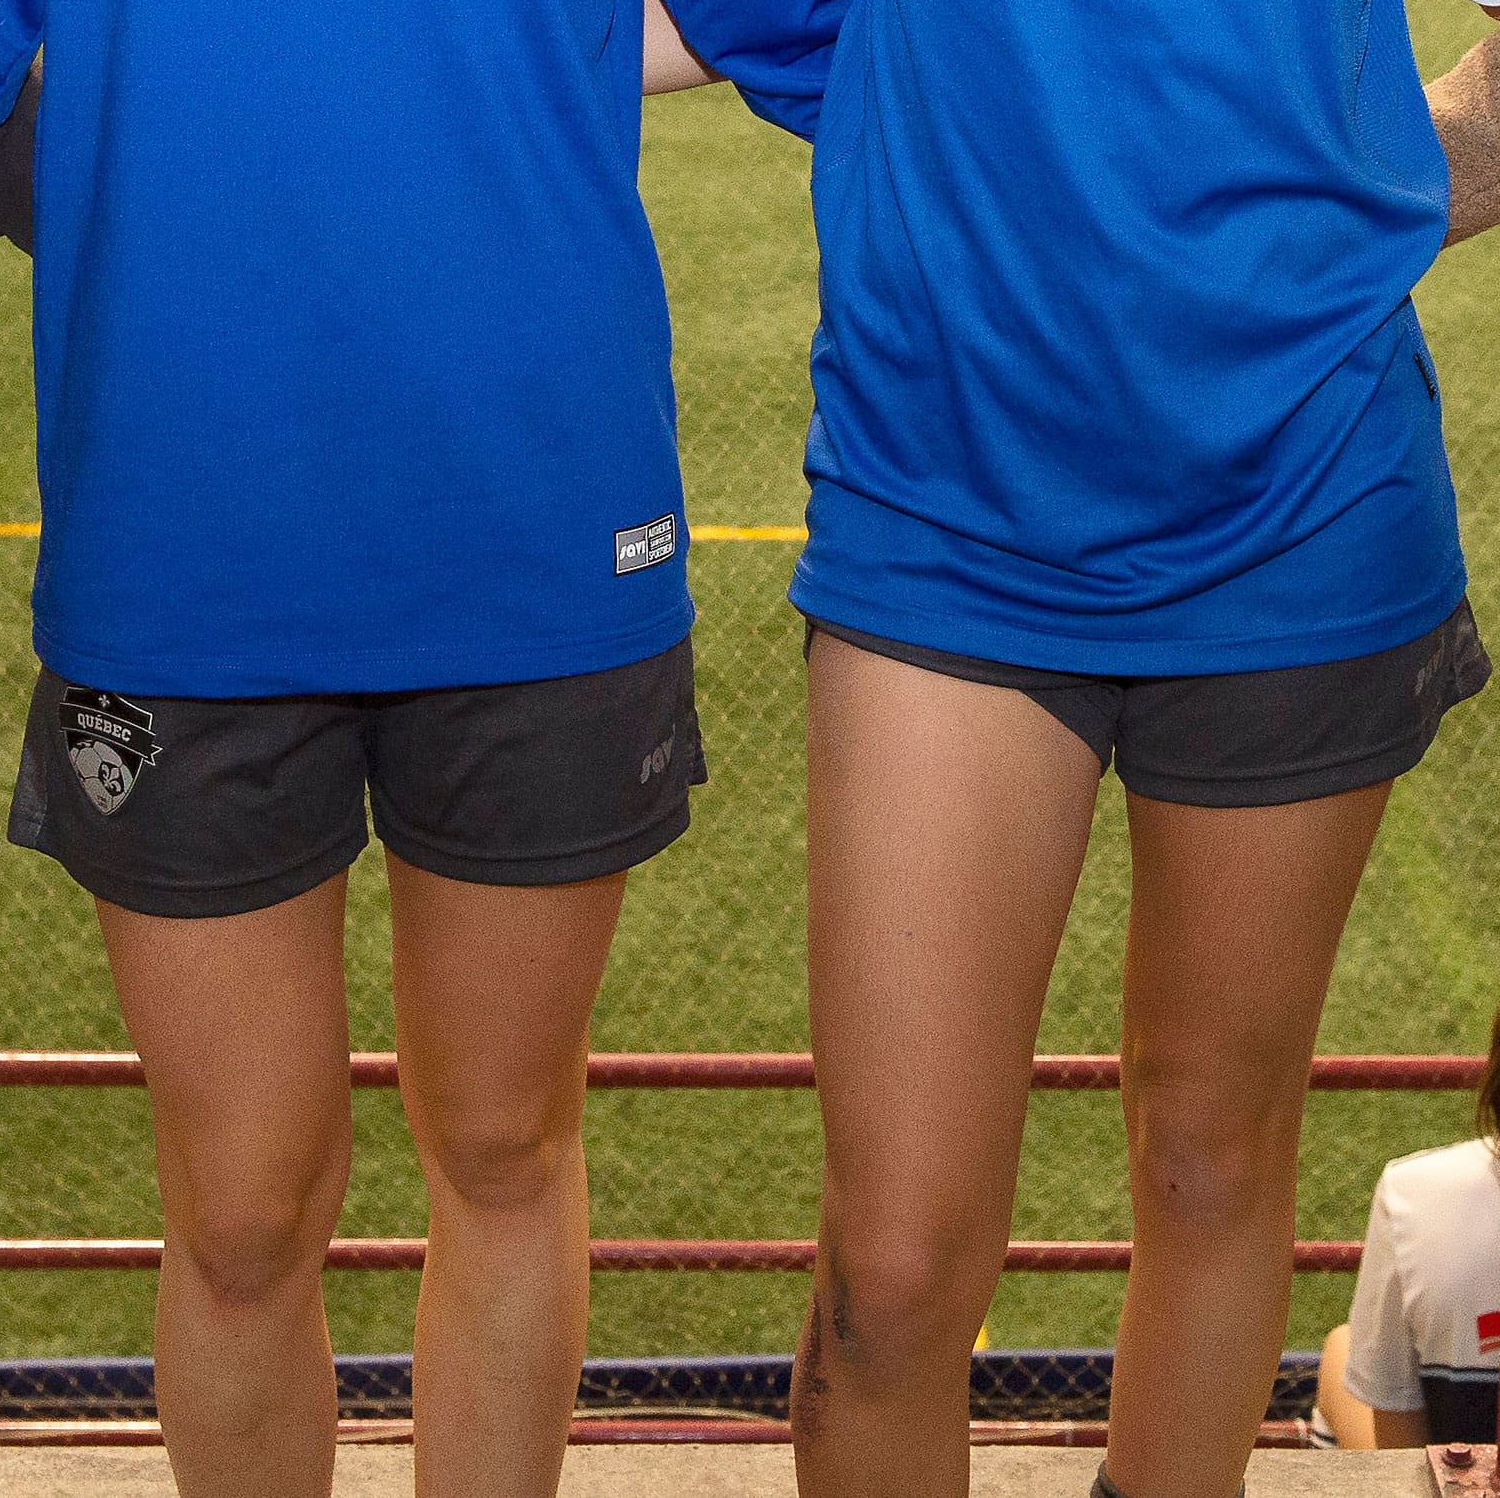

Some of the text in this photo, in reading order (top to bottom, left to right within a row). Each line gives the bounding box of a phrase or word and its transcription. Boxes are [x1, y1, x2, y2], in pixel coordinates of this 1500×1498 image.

[619, 539, 646, 561] savi
[77, 712, 132, 742] QUÉBEC
[640, 723, 676, 784] sav
